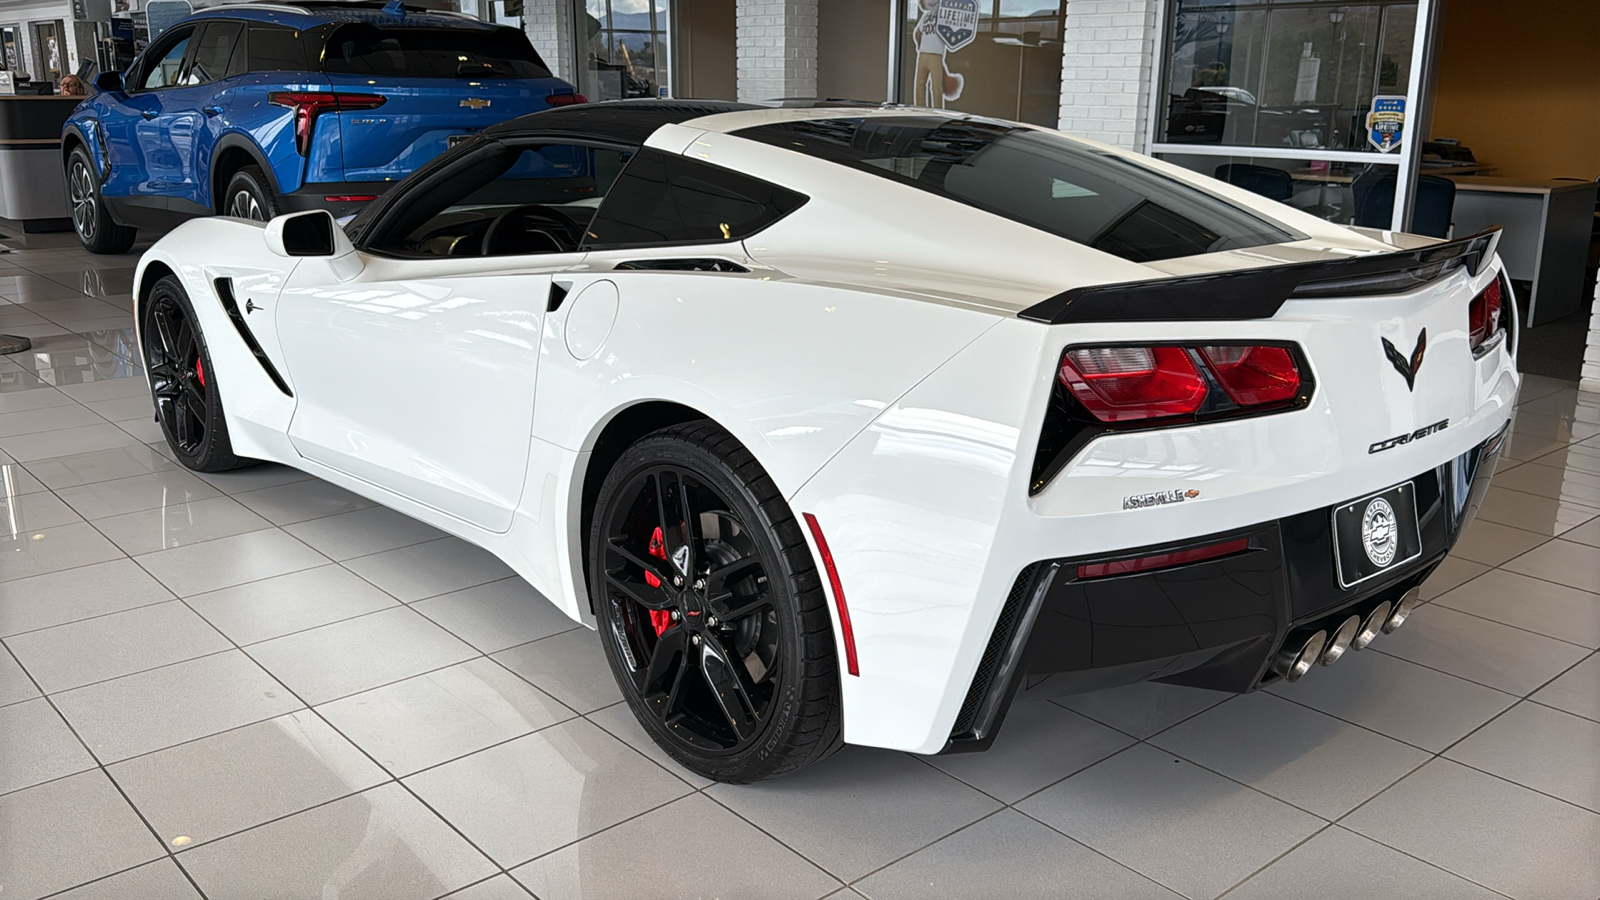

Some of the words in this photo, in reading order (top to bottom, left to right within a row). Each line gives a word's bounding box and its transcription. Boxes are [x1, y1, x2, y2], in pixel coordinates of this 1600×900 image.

[939, 9, 975, 24] LIFETIME
[944, 1, 973, 11] CARFAX
[1368, 418, 1450, 455] CORVETTE
[1122, 489, 1185, 510] ASHEVILLE
[1369, 540, 1396, 563] CHEVROLET
